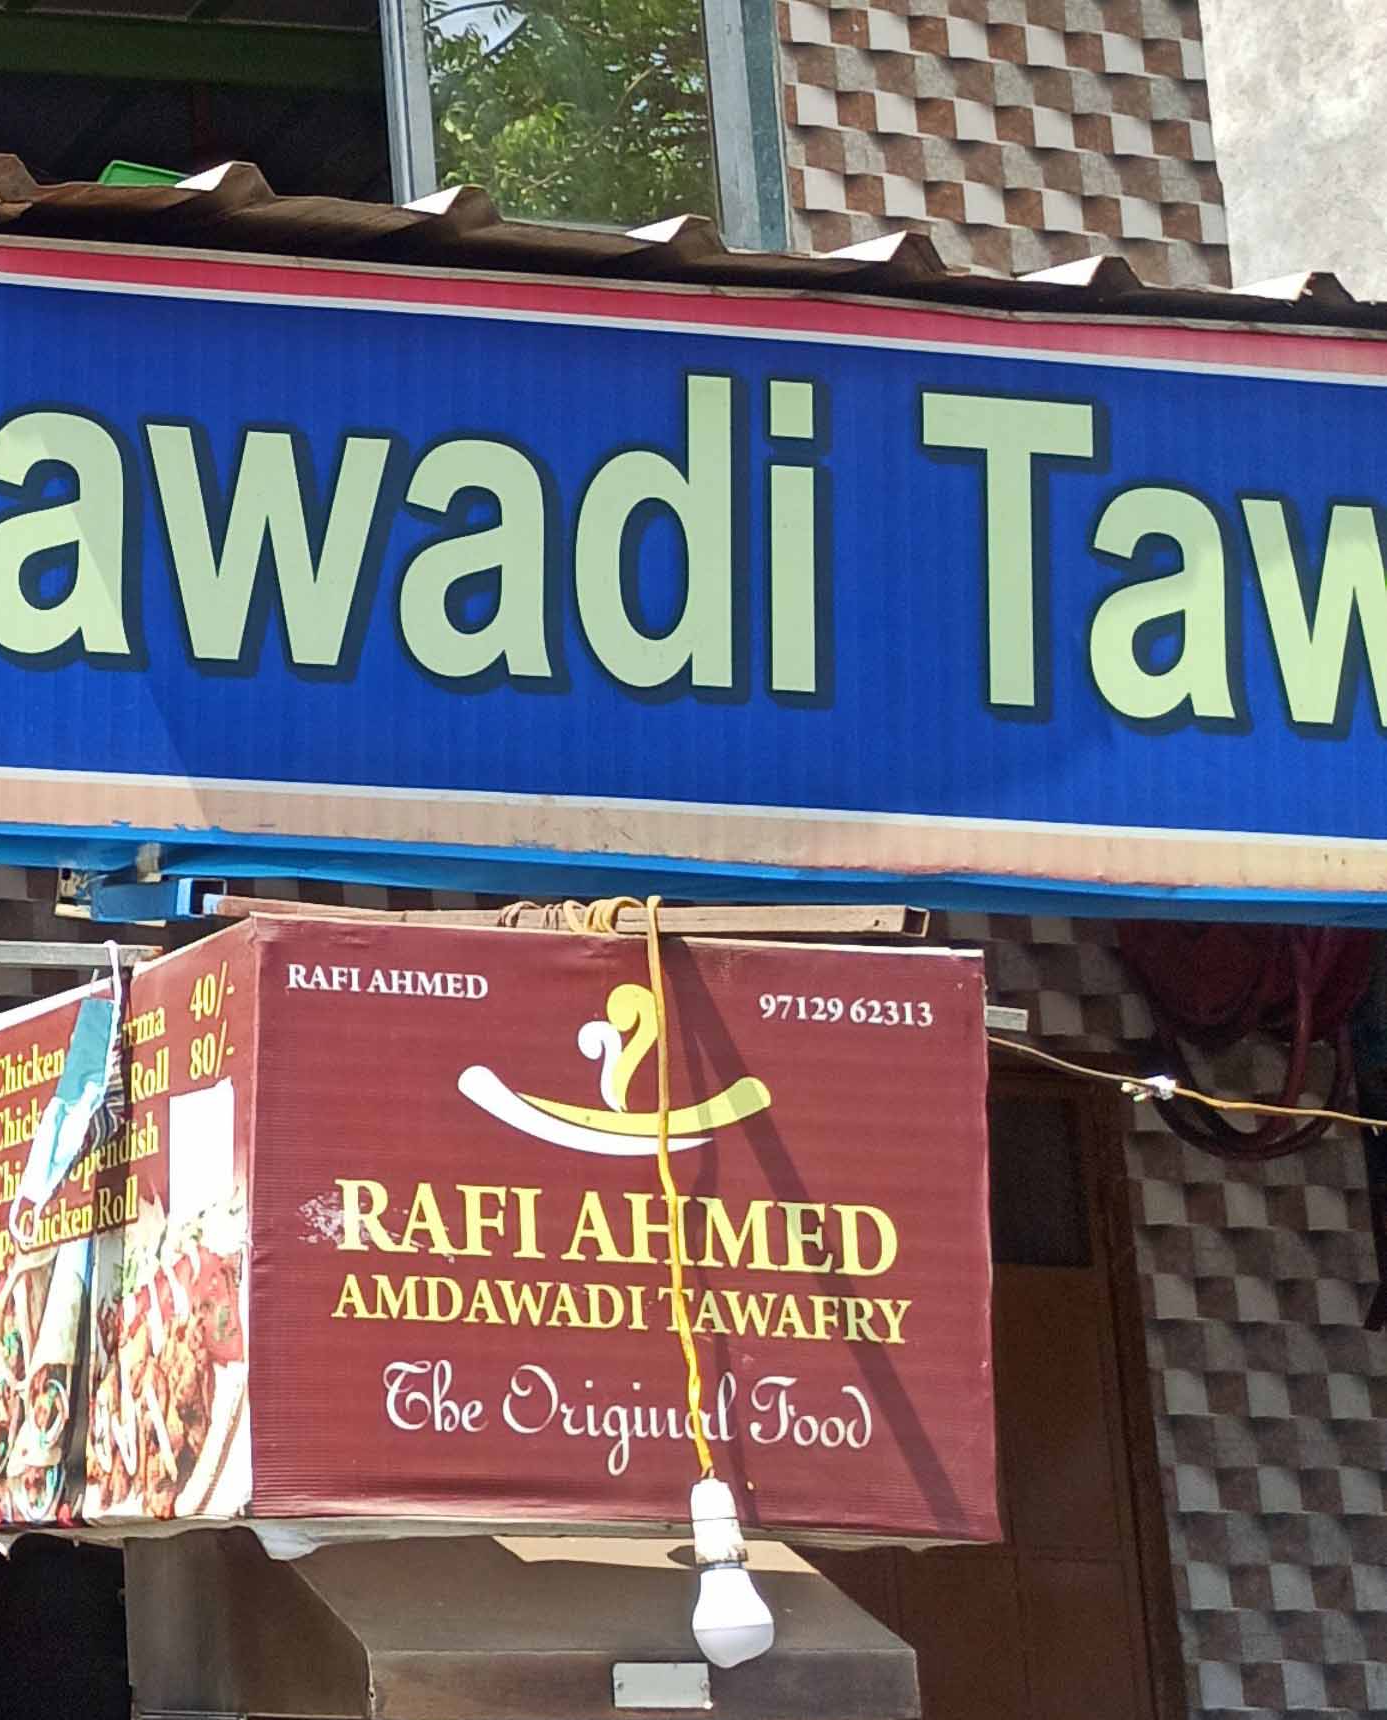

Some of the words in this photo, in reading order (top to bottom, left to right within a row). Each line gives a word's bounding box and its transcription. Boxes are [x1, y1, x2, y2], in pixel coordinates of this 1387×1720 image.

[921, 391, 1387, 726] Taw
[287, 963, 361, 994] RAFI
[369, 966, 489, 999] AHMED
[759, 993, 844, 1024] 97129
[850, 998, 933, 1028] 62313
[131, 1046, 170, 1105] Roll
[97, 1174, 139, 1229] Roll
[333, 1178, 547, 1258] RAFI
[561, 1190, 898, 1278] AHMED
[331, 1273, 646, 1332] AMDAWADI
[658, 1285, 913, 1345] TAWAFRY
[382, 1360, 488, 1432] The
[502, 1363, 737, 1477] Original
[748, 1375, 873, 1449] Food
